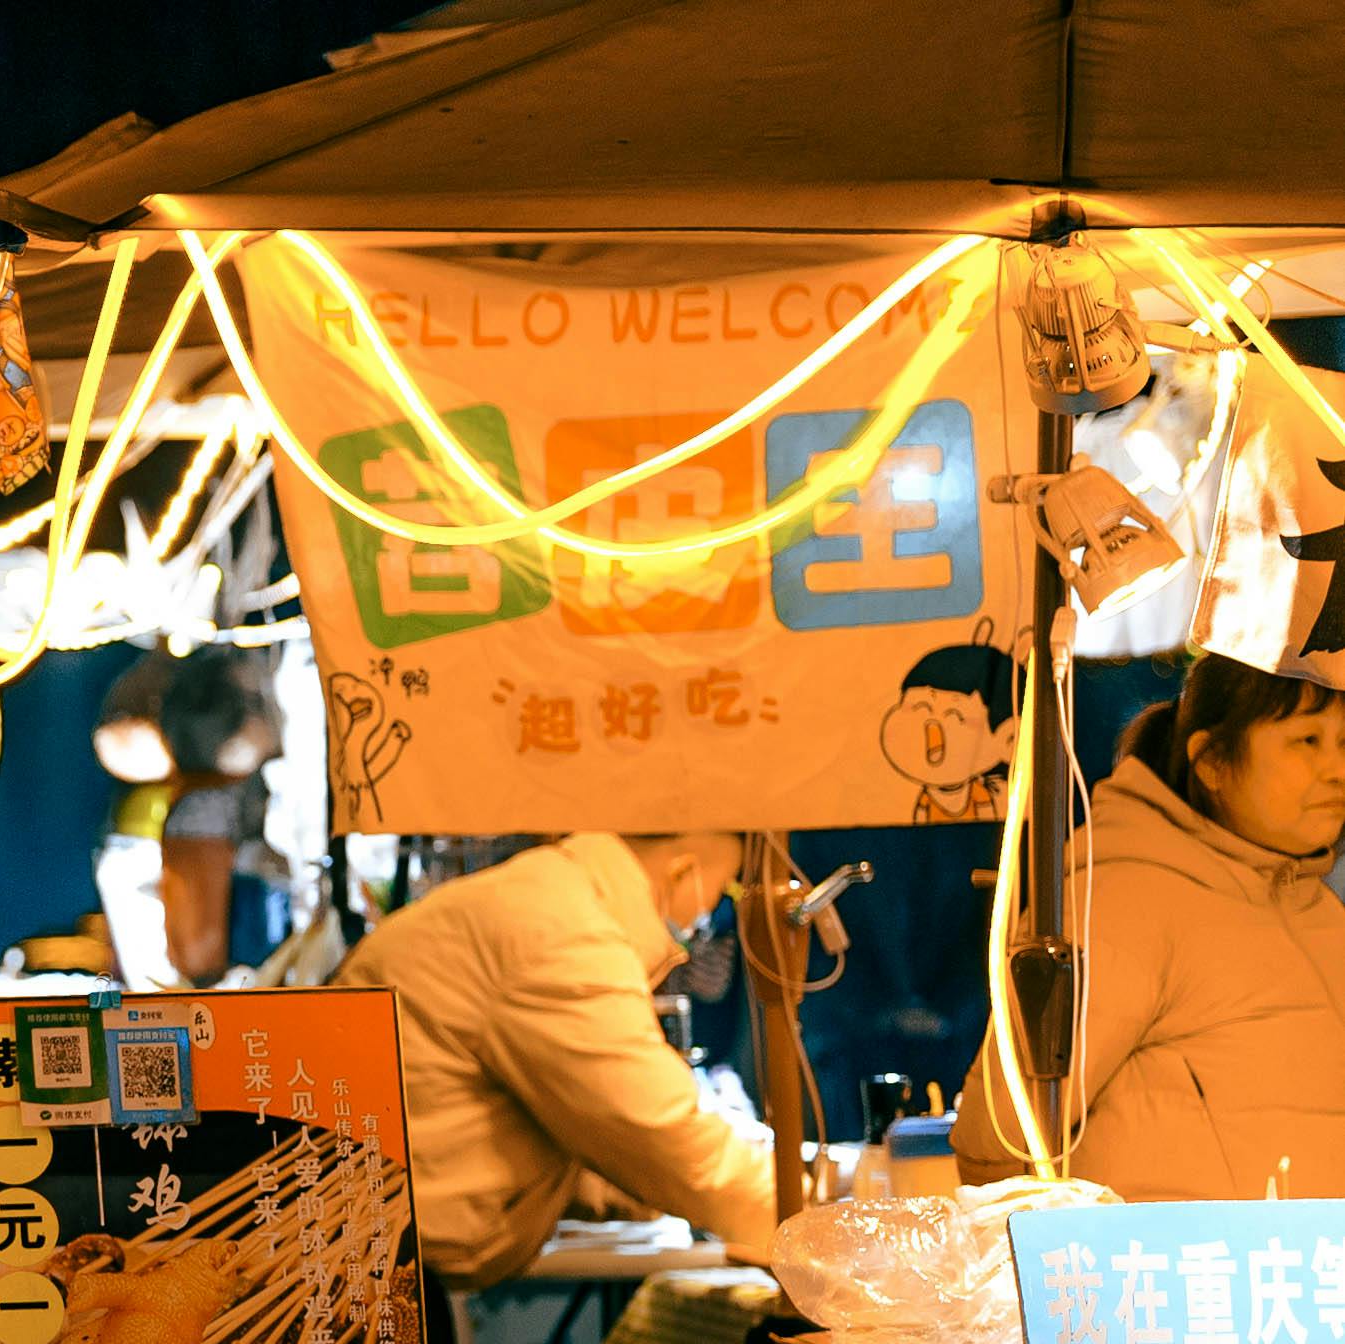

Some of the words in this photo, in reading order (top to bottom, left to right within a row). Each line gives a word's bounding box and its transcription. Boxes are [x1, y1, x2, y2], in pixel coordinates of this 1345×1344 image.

[315, 290, 569, 347] HELLO
[515, 667, 749, 755] 超好吃
[194, 1011, 210, 1042] 乐山
